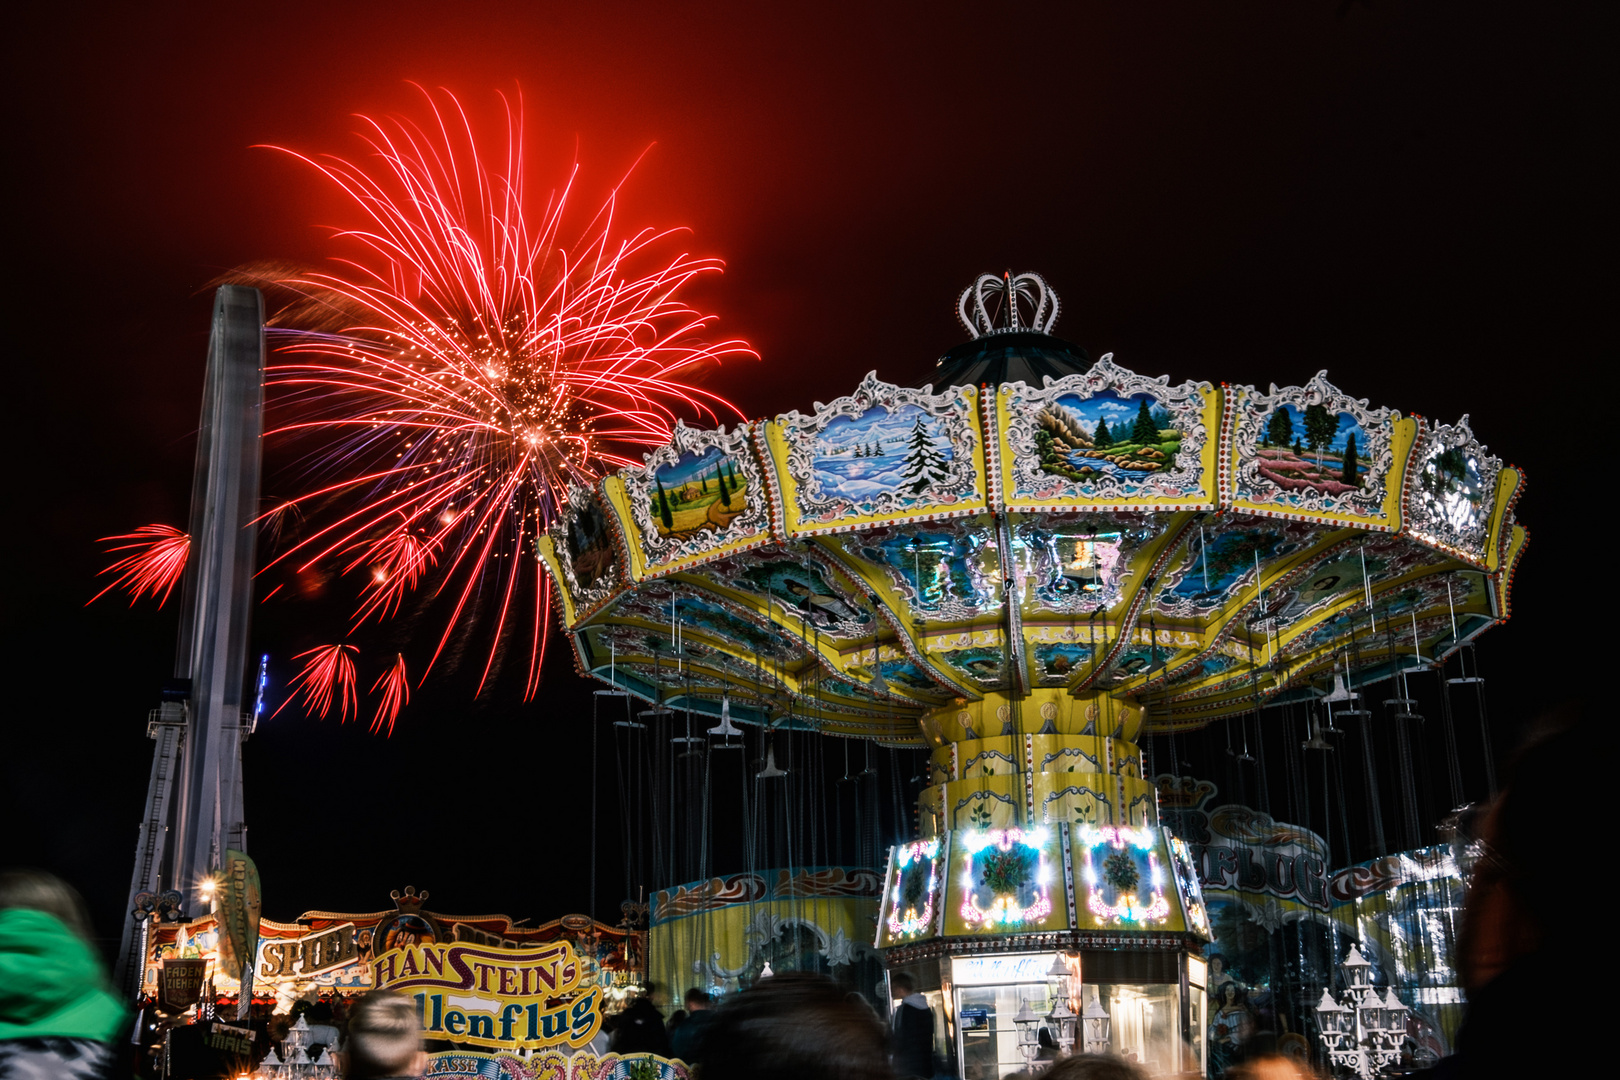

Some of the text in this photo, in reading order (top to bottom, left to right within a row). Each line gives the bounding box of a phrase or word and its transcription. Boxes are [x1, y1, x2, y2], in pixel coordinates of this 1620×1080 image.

[261, 927, 357, 977] SPIEL
[166, 966, 203, 978] FADEN
[167, 978, 200, 990] ZIEHEN
[211, 1033, 252, 1055] MAIS
[426, 1058, 478, 1076] KASSE
